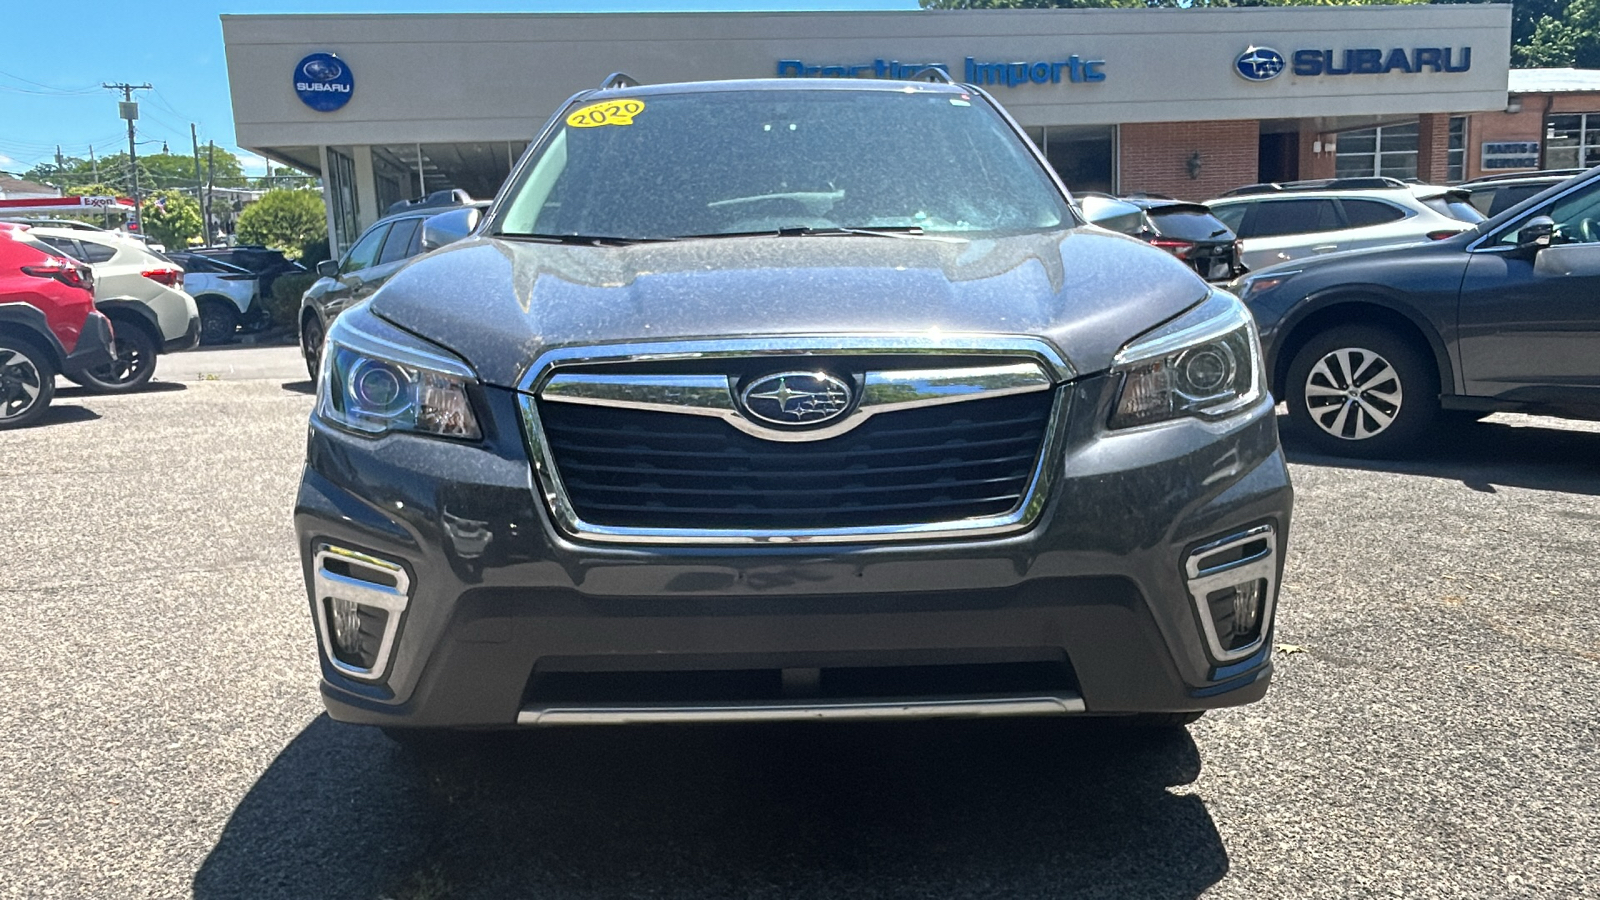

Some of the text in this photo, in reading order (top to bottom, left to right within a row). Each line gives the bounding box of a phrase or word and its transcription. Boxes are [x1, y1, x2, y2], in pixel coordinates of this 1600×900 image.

[777, 54, 1107, 88] Prti Imports
[1293, 47, 1472, 76] SUBARU
[296, 82, 350, 93] SUBARU
[572, 102, 640, 124] 2020
[84, 197, 113, 208] Exxon
